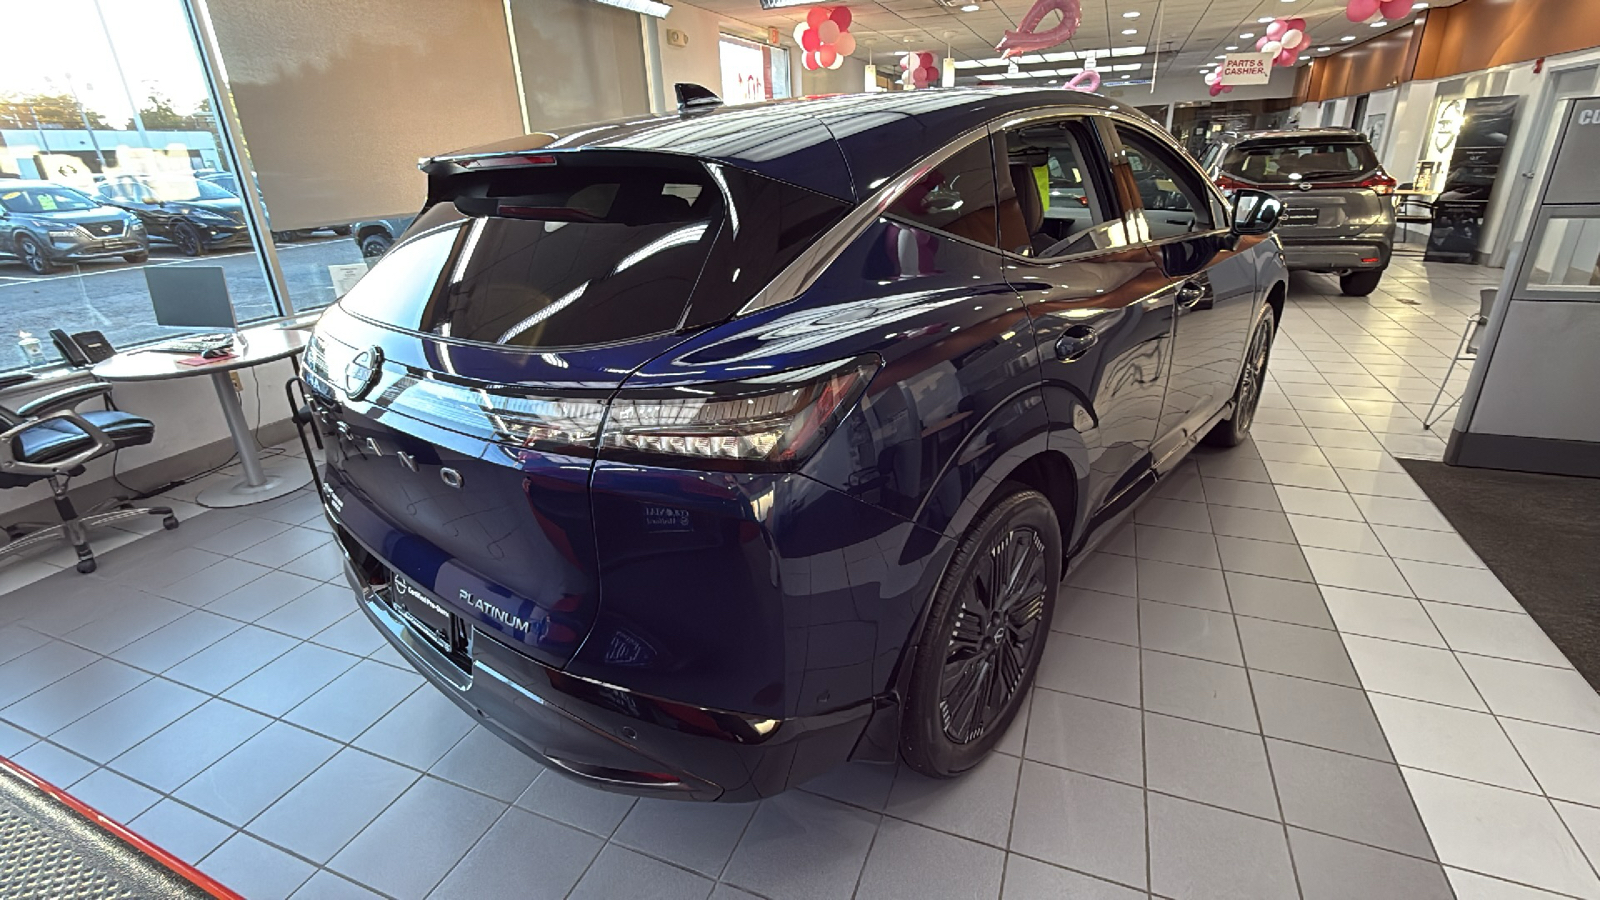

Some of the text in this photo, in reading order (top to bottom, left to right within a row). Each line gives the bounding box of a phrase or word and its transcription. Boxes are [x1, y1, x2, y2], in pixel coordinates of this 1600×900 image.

[1227, 59, 1263, 67] PARTS &
[1224, 67, 1264, 76] CASHIER
[459, 589, 529, 634] PLATINUM
